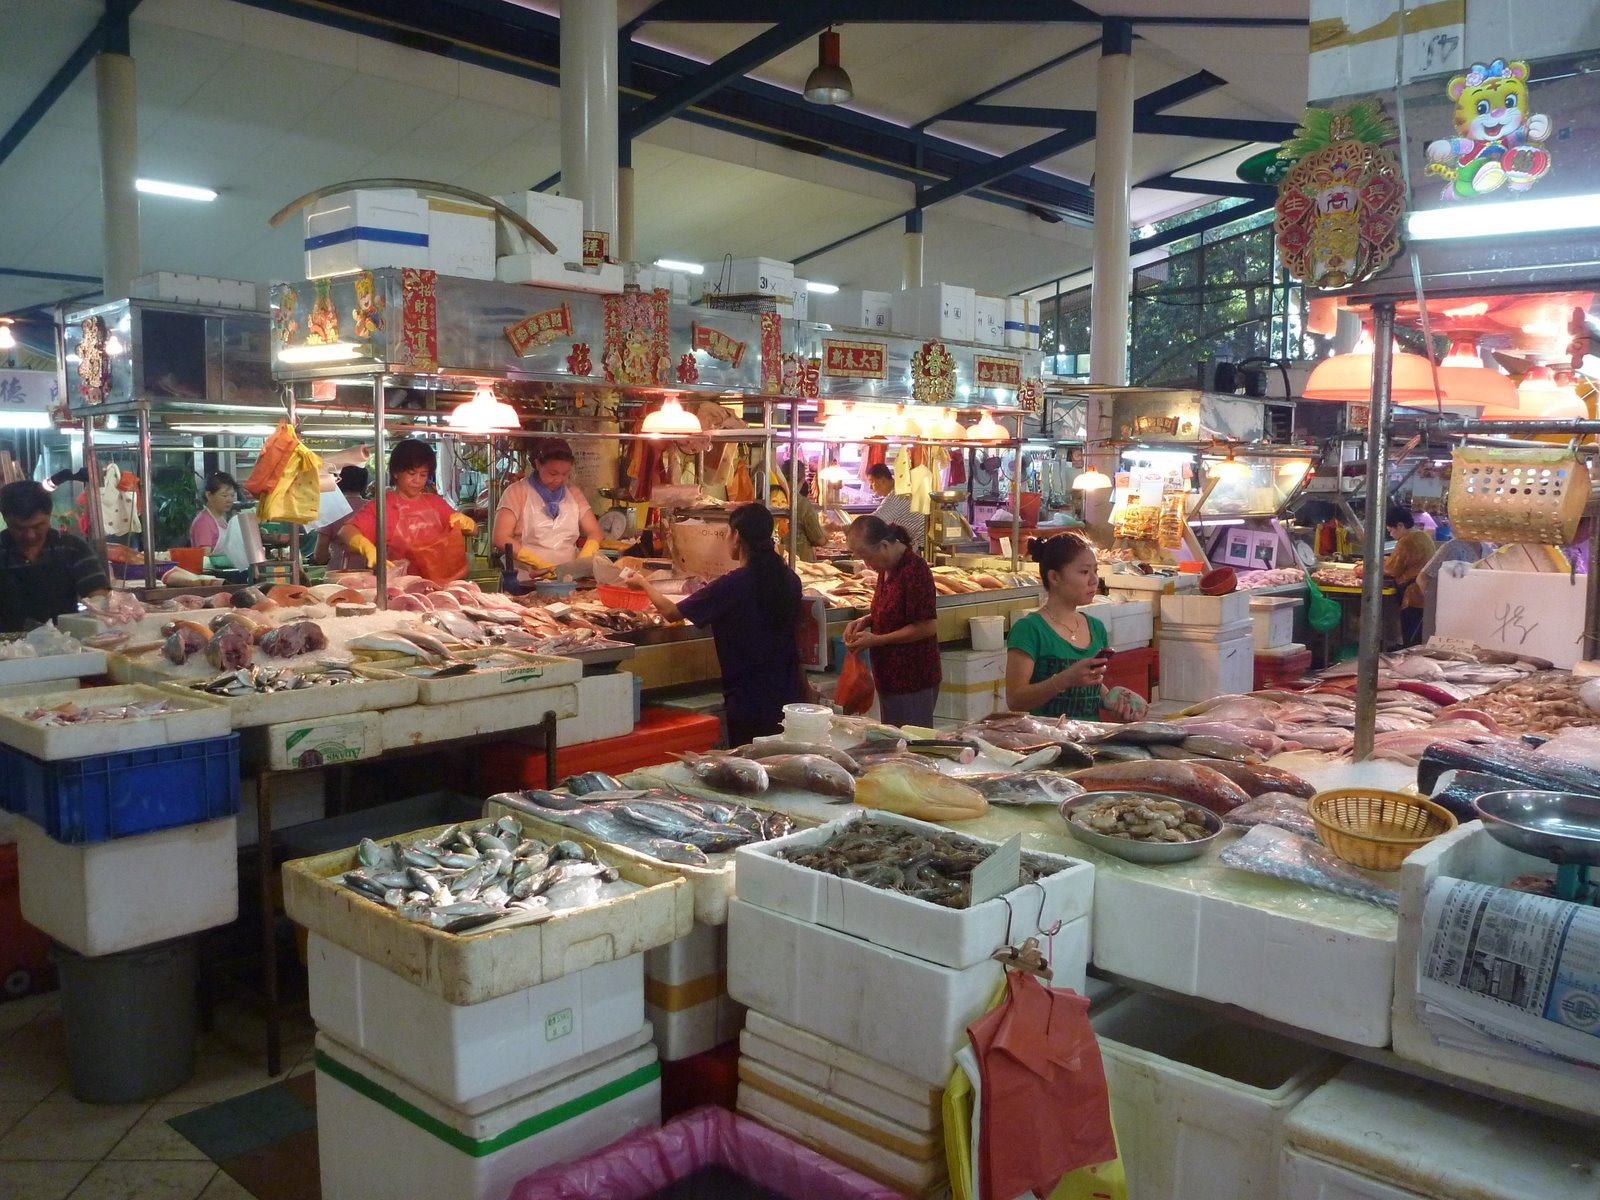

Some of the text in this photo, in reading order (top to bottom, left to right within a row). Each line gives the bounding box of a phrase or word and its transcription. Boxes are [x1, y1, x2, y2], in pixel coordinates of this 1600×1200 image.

[831, 348, 881, 371] 新春大吉
[980, 365, 1018, 384] 如意吉祥
[326, 748, 361, 761] ADAMS
